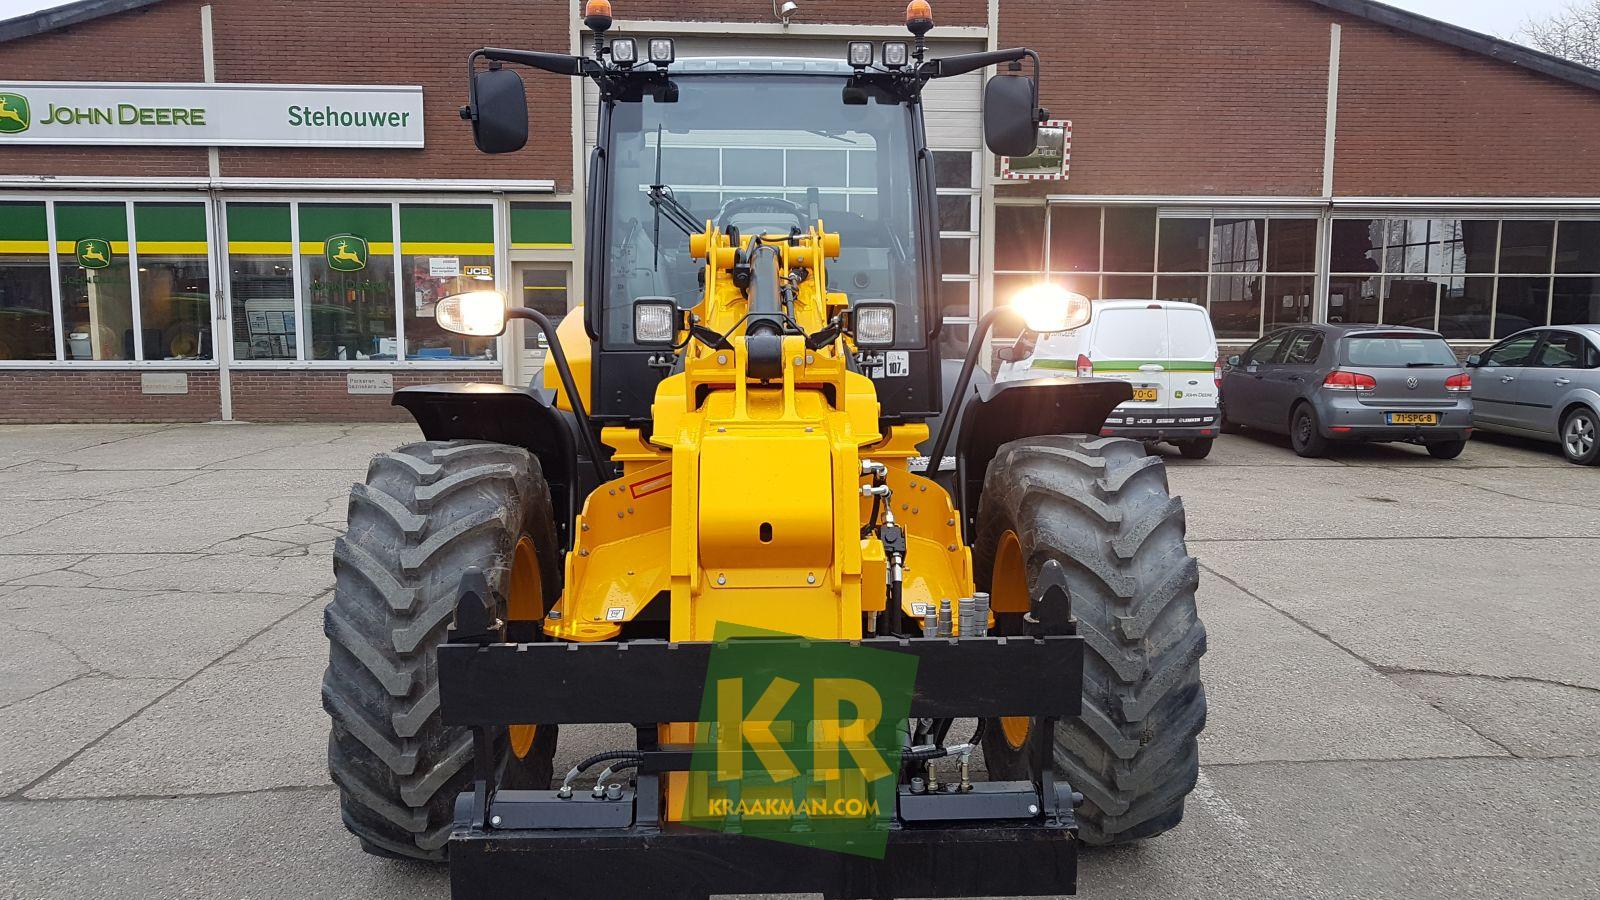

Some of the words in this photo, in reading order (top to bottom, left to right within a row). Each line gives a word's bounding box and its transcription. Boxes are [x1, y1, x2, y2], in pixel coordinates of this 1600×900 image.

[40, 103, 113, 125] JOHN
[117, 104, 207, 126] DEERE
[288, 106, 410, 128] Stehouwer
[466, 267, 490, 275] JCB
[889, 362, 901, 374] 107
[1396, 414, 1432, 422] 71-SPG-8
